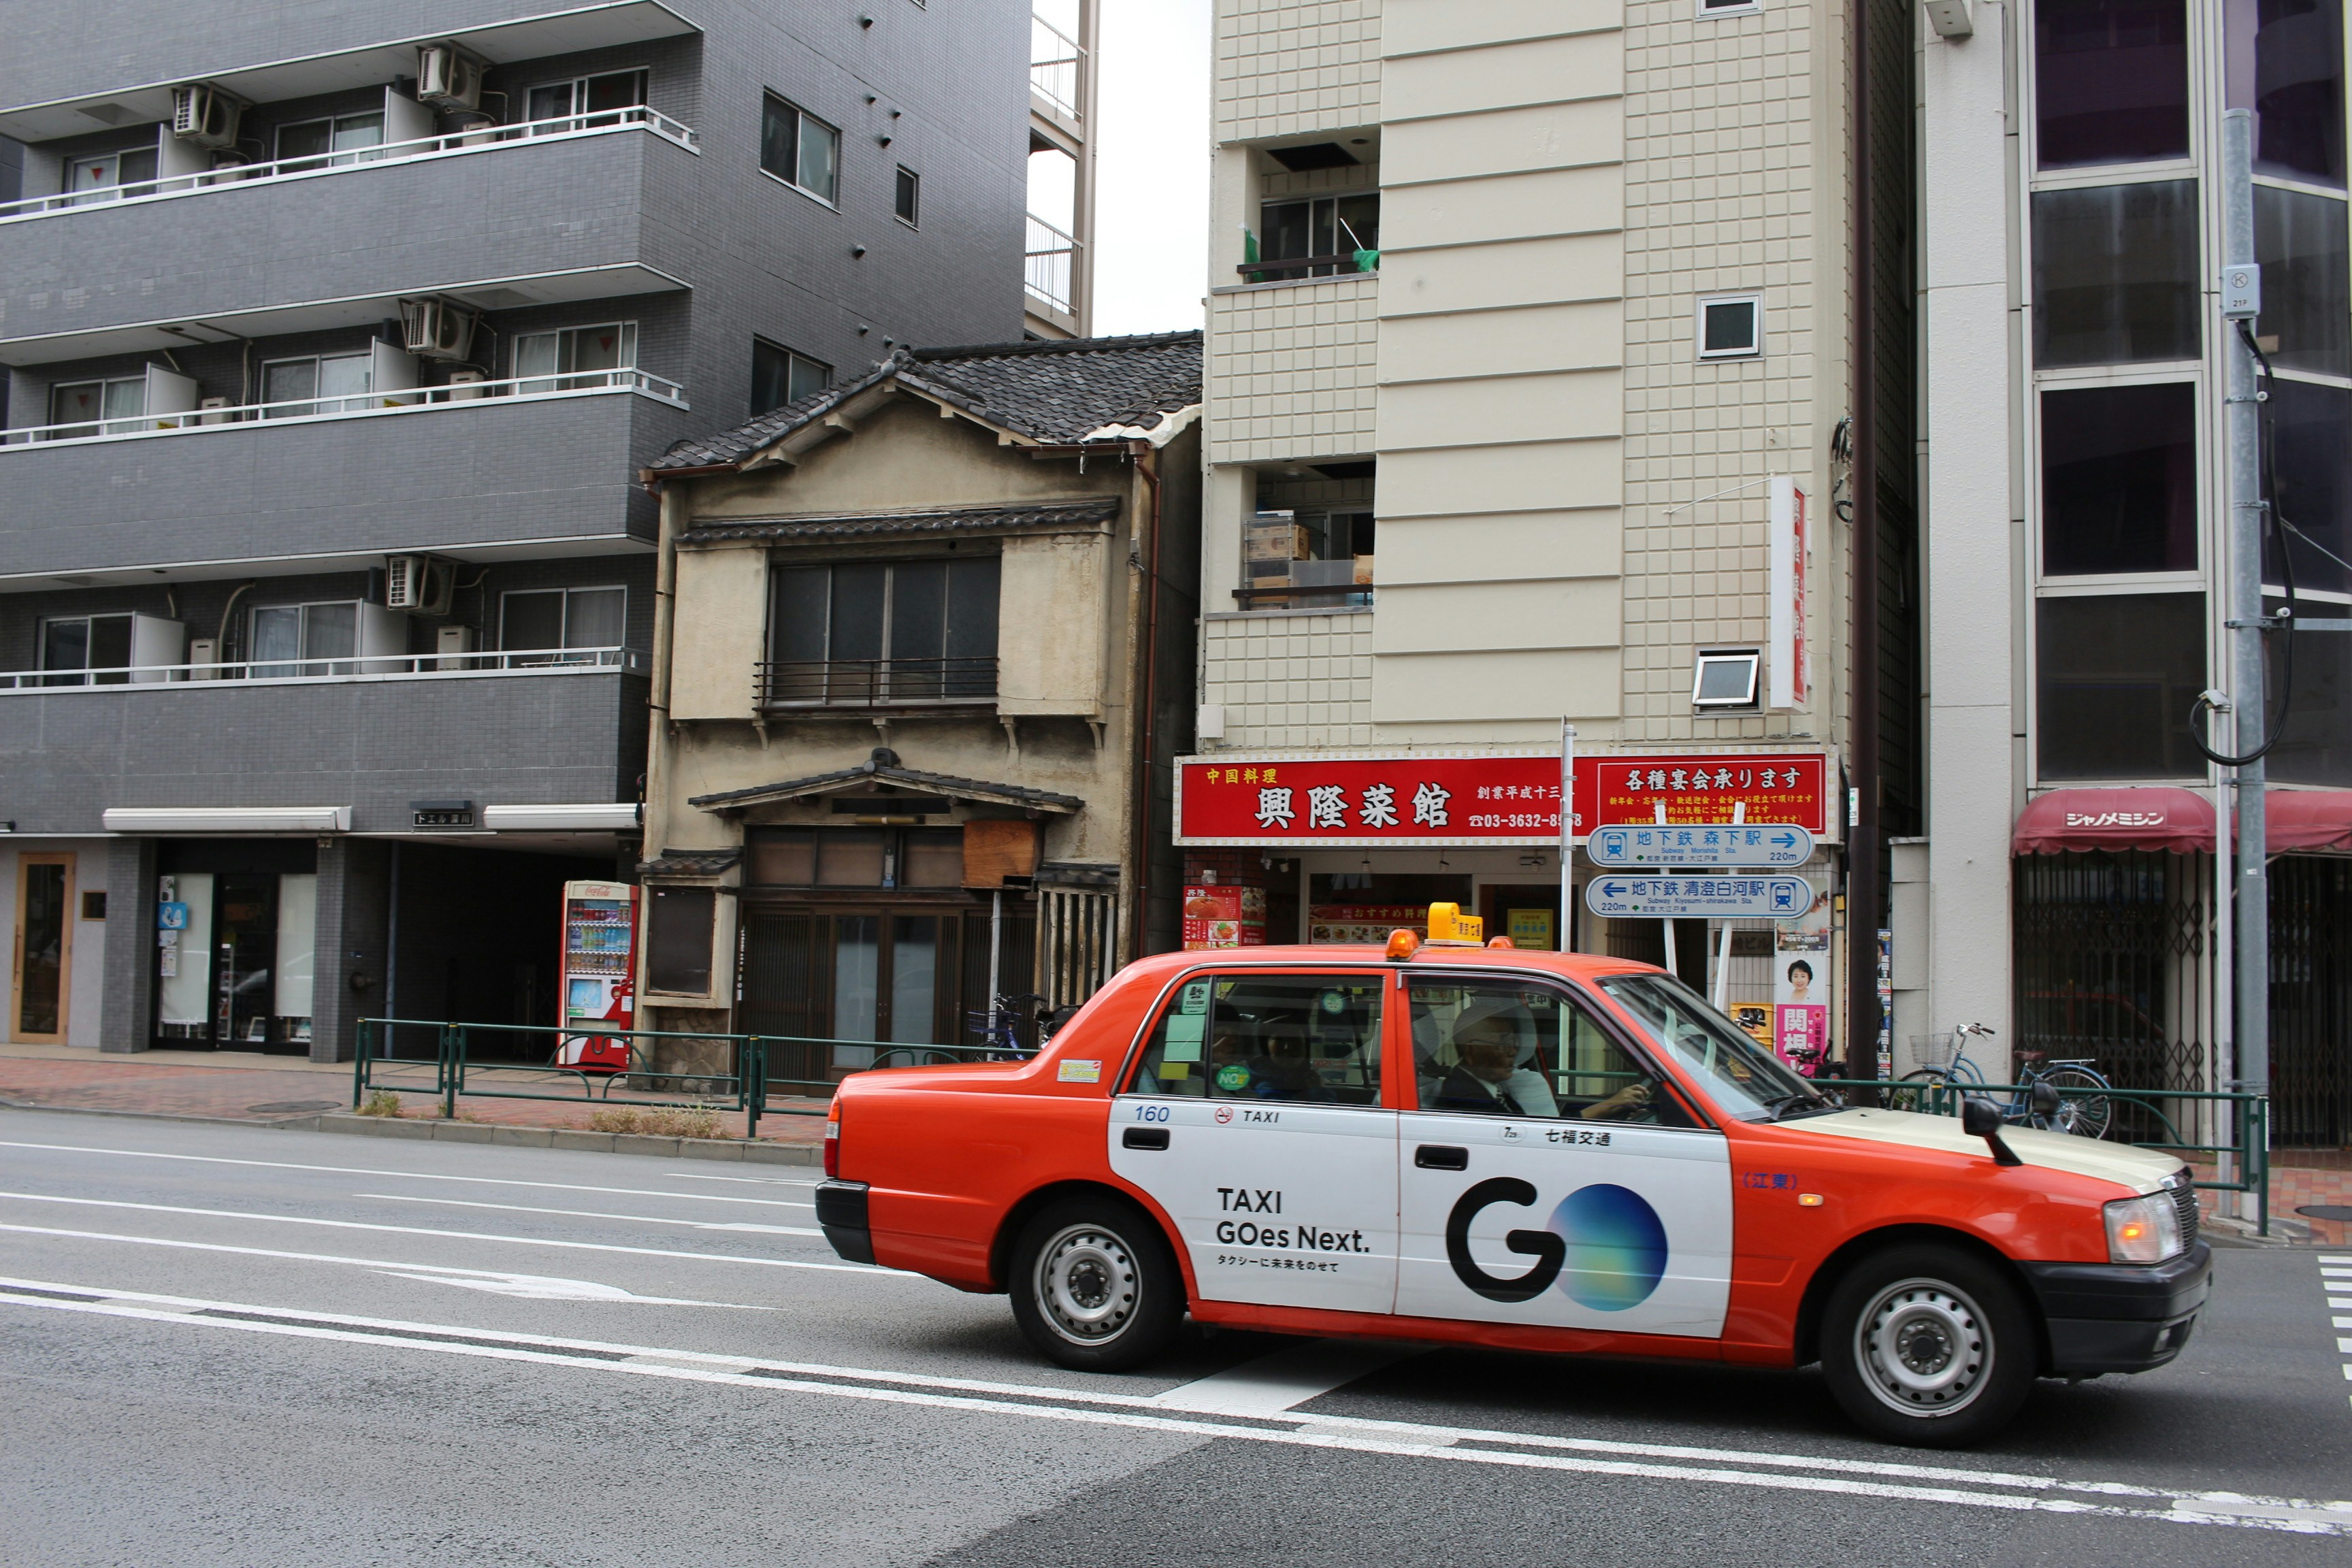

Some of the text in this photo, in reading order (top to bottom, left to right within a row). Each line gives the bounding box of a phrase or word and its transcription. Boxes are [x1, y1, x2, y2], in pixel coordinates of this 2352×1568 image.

[1207, 768, 1277, 784] 中国料理
[1624, 767, 1801, 791] 各種宴会承ります
[1477, 785, 1575, 800] 創業平成十三
[1254, 782, 1452, 830] 興隆菜館
[418, 814, 446, 823] ドエル
[1484, 813, 1582, 828] 03-3632-88
[2066, 813, 2164, 826] ジャノメミシン
[1637, 830, 1761, 846] 地下鉄 森下駅
[1769, 852, 1797, 861] 220m
[1631, 881, 1765, 896] 地下鉄 清澄白河駅
[1354, 908, 1427, 919] おすすめ料理
[1601, 902, 1627, 911] 220m
[1134, 1105, 1169, 1122] 160
[1243, 1110, 1280, 1123] TAXI
[1546, 1128, 1611, 1146] 七福交通
[1742, 1172, 1798, 1190] （江東）
[1217, 1188, 1281, 1214] TAXI
[1217, 1220, 1370, 1253] GOes Next.
[1217, 1254, 1339, 1273] タクシーに未来をのせて
